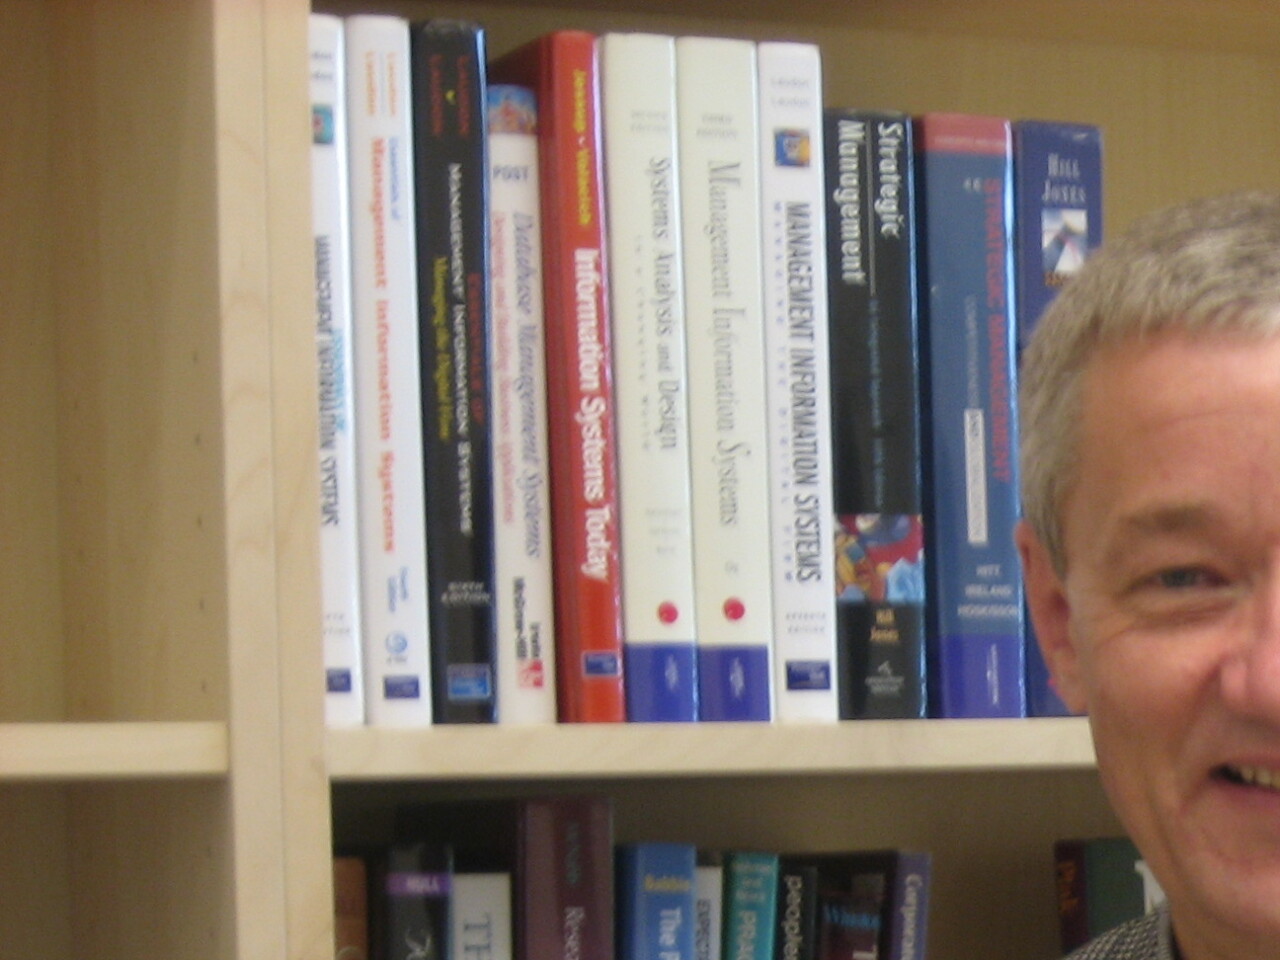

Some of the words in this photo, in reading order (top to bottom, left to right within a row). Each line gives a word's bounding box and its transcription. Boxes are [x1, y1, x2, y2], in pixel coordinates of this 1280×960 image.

[369, 138, 387, 289] Management
[493, 165, 528, 181] POST
[645, 156, 673, 240] Systems
[832, 118, 867, 287] Management
[874, 121, 905, 240] Strategic
[449, 163, 463, 298] MANAGEMENT
[512, 212, 534, 316] Database
[705, 161, 743, 298] Management
[786, 202, 815, 342] MANAGEMENT
[983, 177, 1006, 309] STRATEGIC
[574, 248, 602, 391] Information
[650, 251, 677, 336] Analysis
[375, 299, 392, 441] Information
[452, 304, 468, 435] INFORMATION
[515, 323, 540, 466] Management
[658, 343, 672, 372] and
[707, 306, 748, 433] Information
[988, 315, 1010, 483] MANAGEMENT
[576, 396, 607, 502] Systems
[655, 379, 680, 450] Design
[789, 347, 818, 487] INFORMATION
[377, 451, 396, 553] Systems
[457, 441, 472, 535] SYSTEMS
[518, 468, 543, 558] Systems
[711, 439, 751, 527] Systems
[794, 492, 821, 583] SYSTEMS
[581, 503, 612, 583] Today
[659, 907, 681, 941] The
